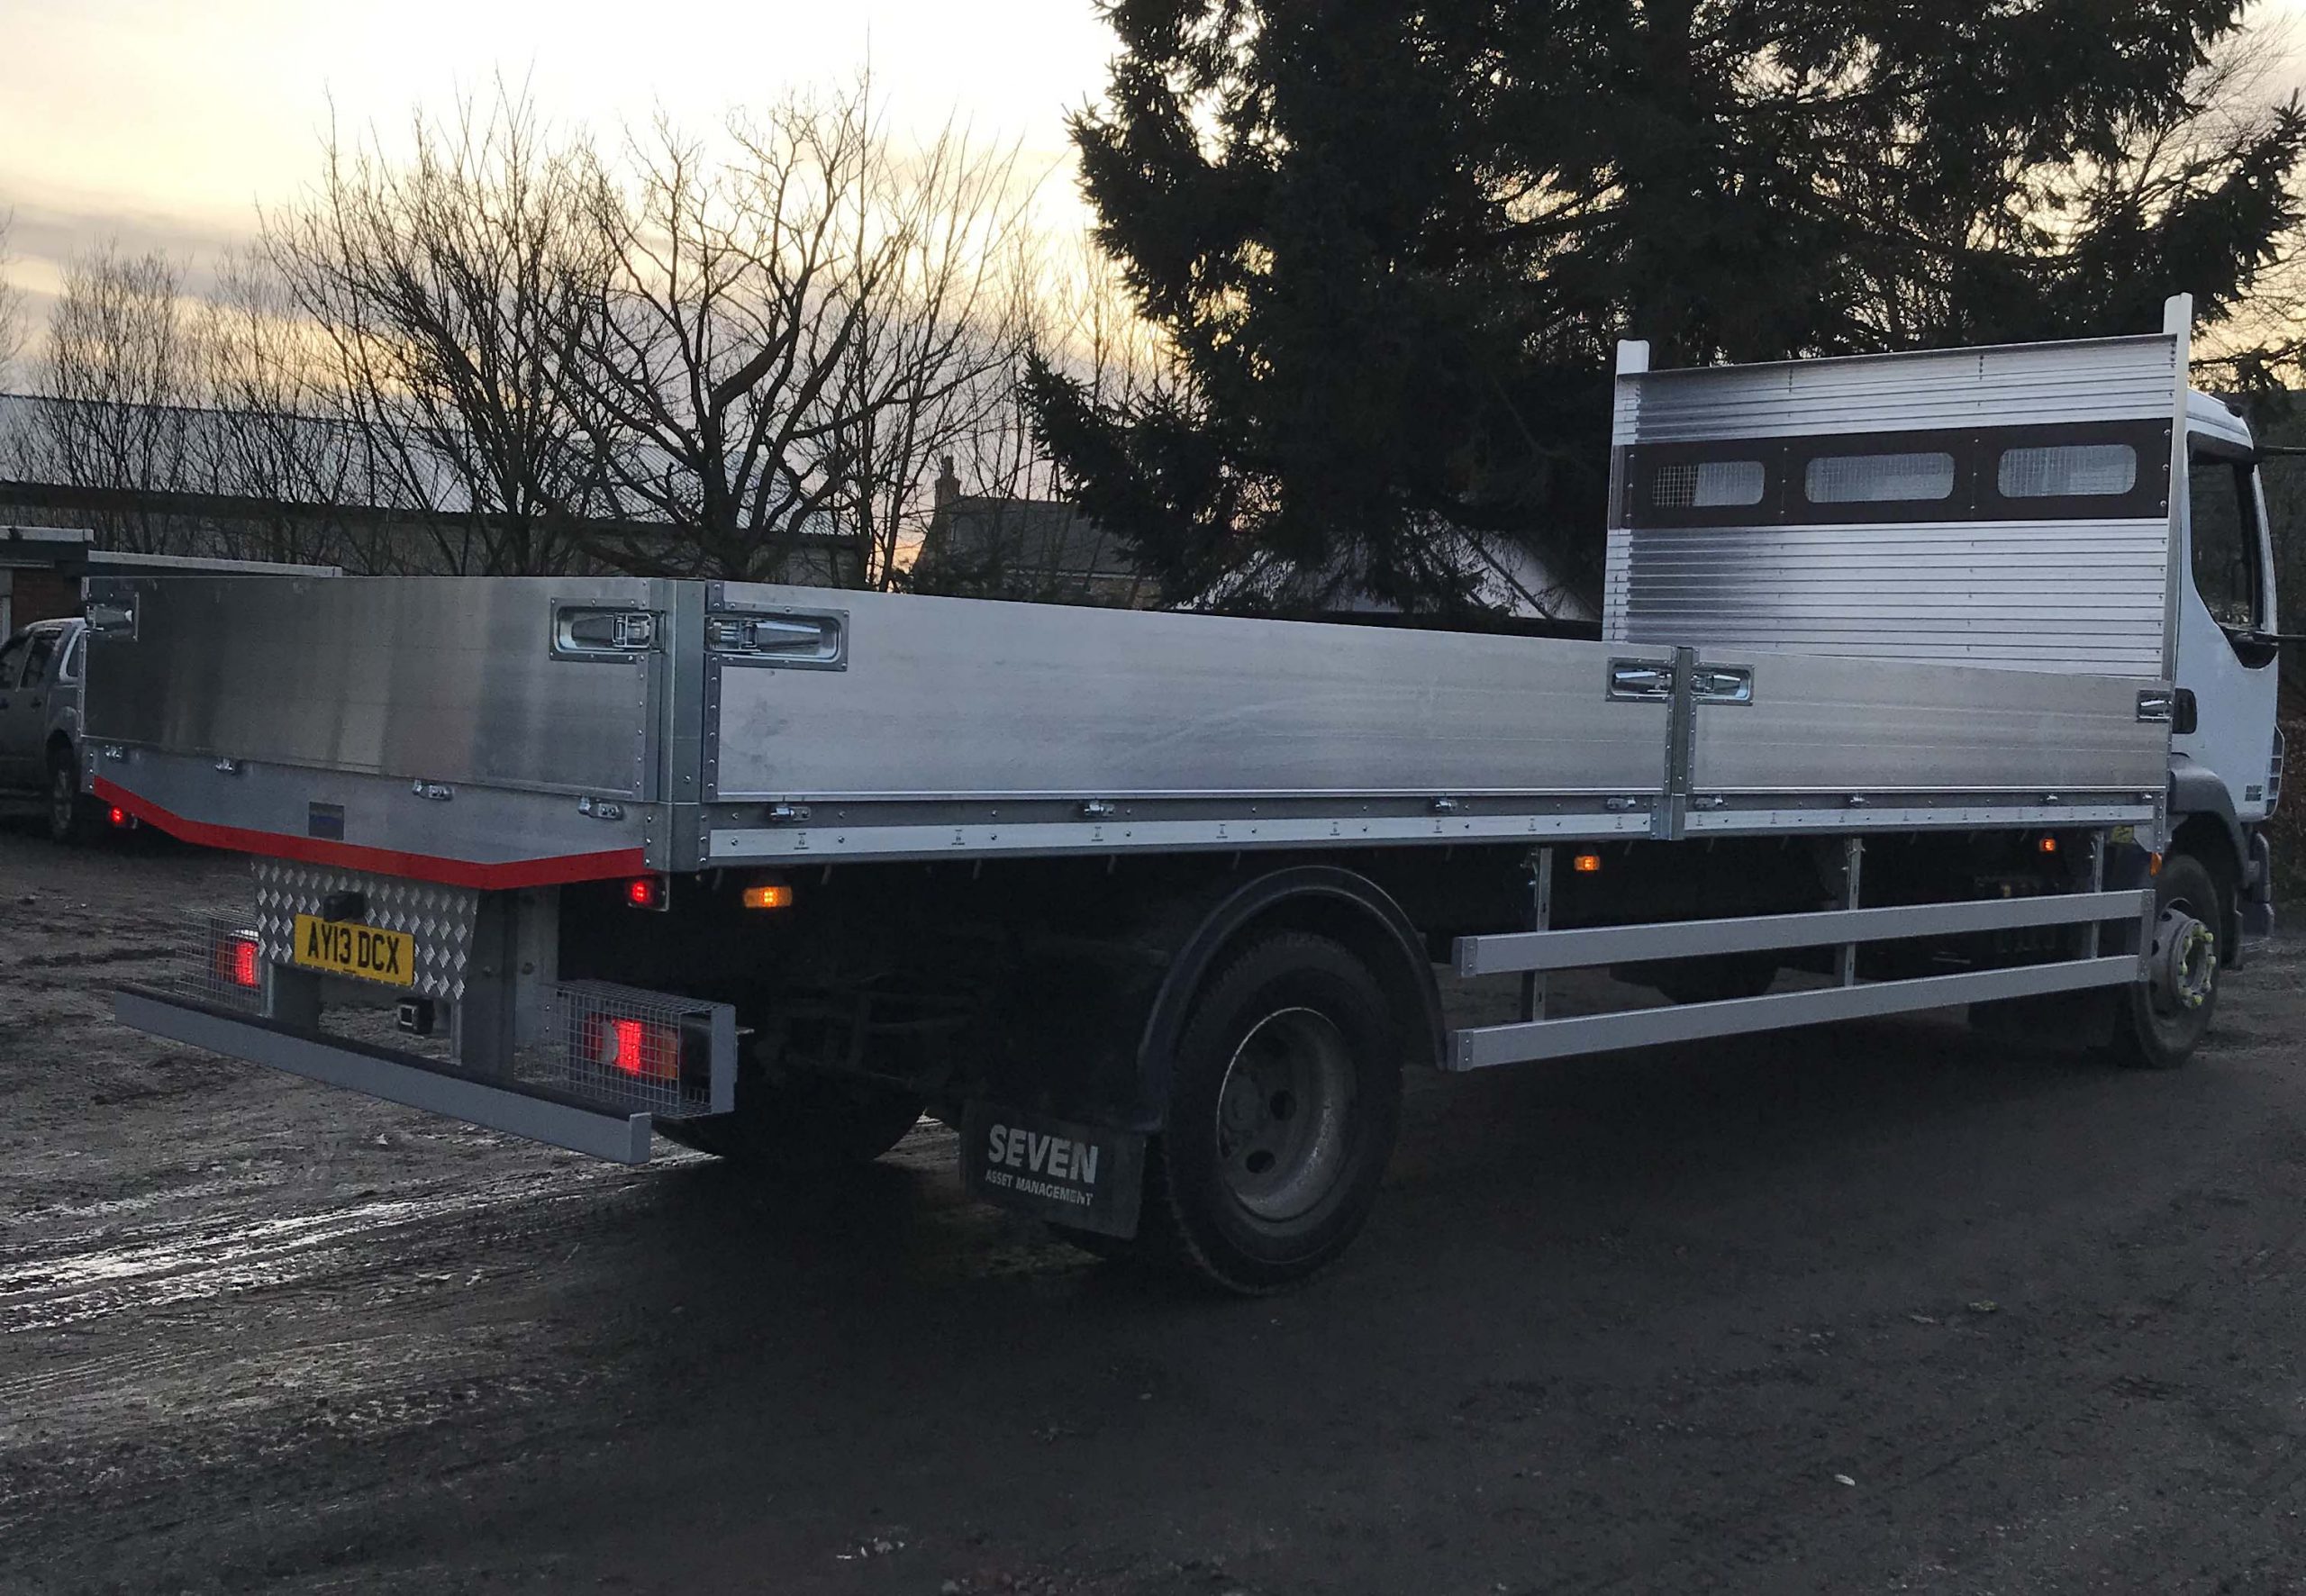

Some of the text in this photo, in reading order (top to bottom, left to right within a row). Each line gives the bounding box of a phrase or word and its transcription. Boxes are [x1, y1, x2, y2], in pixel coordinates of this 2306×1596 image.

[307, 920, 400, 975] AY13 DCX
[988, 1124, 1098, 1184] SEVEN
[985, 1169, 1094, 1207] ASSET MANAGEMENT
